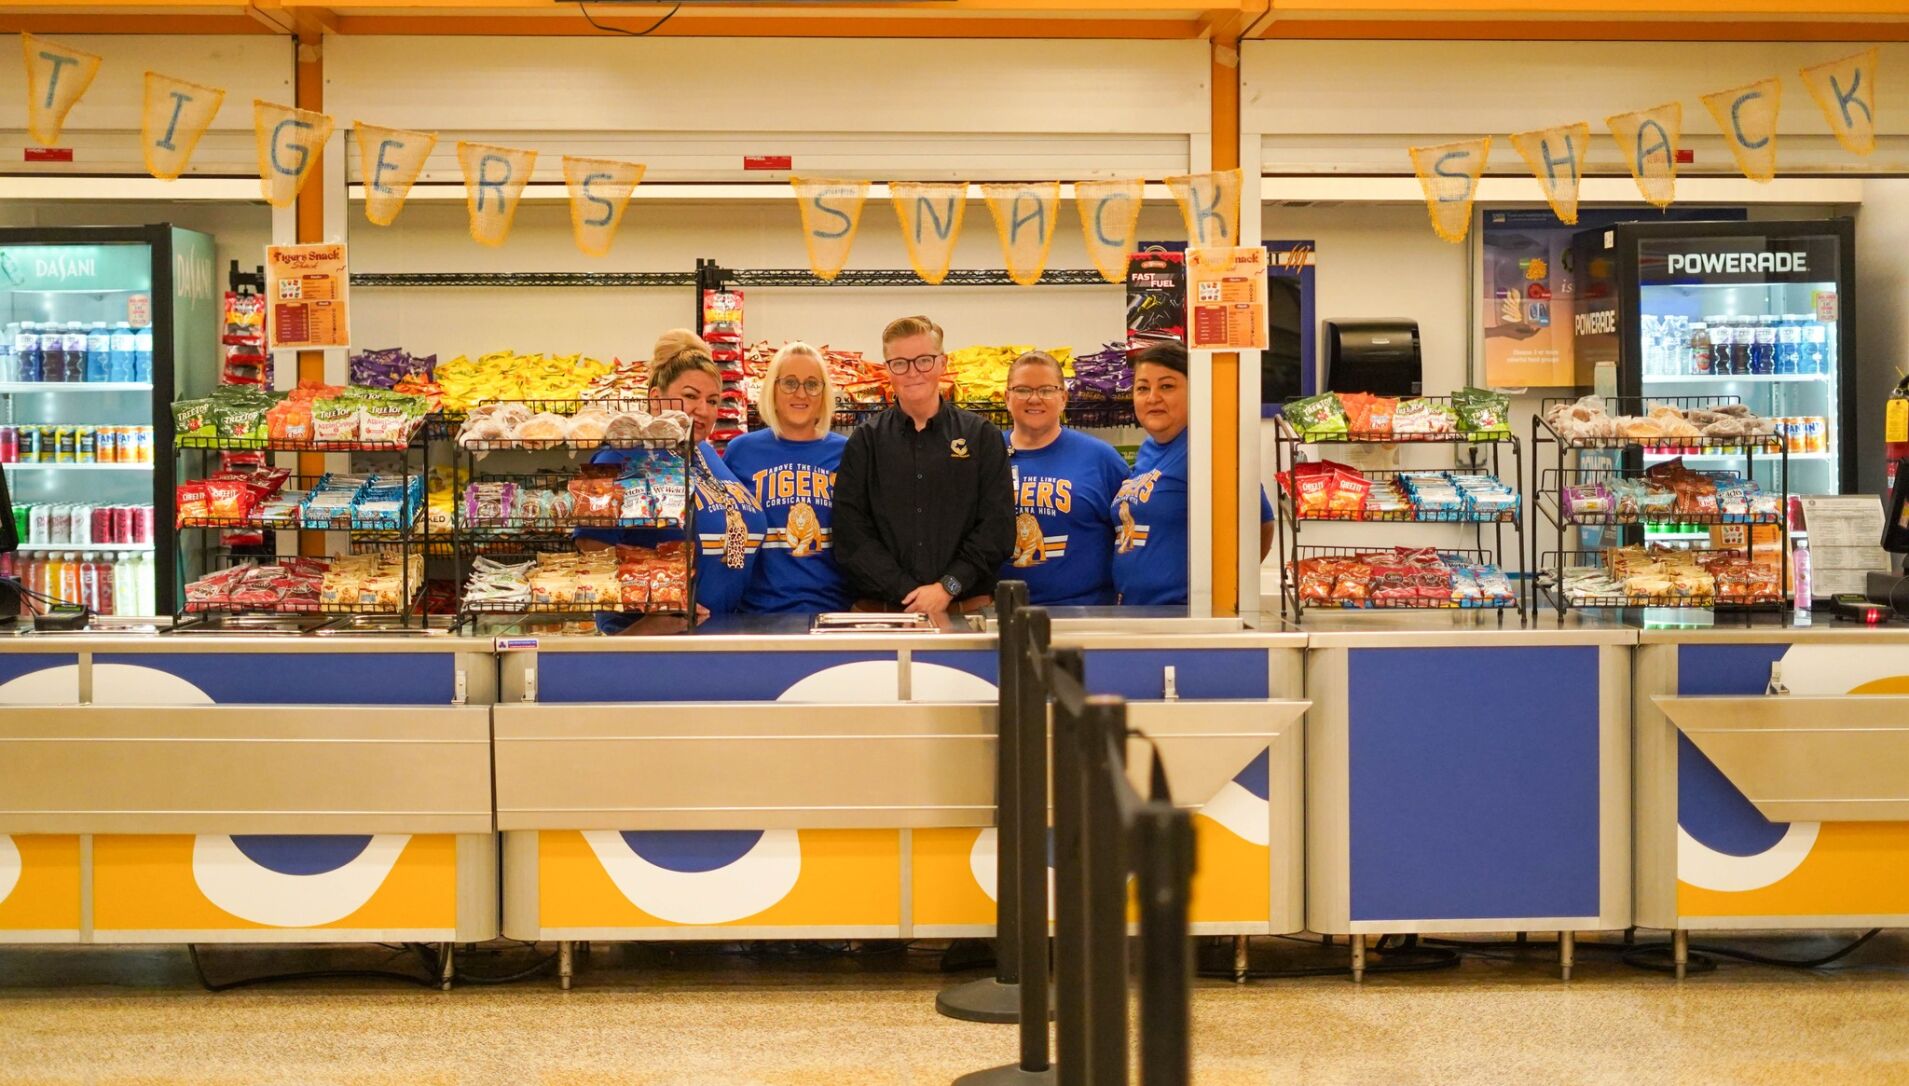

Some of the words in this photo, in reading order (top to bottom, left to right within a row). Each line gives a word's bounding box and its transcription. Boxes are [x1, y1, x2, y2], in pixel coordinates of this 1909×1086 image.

[308, 249, 340, 261] Snack
[35, 255, 96, 282] DASANI
[1667, 252, 1807, 274] POWERADE
[1131, 273, 1155, 281] FAST
[1151, 280, 1175, 288] FUEL
[1575, 310, 1616, 336] POWERADE
[768, 463, 793, 474] ABOVE
[796, 463, 811, 471] THE
[813, 465, 830, 475] LINE
[766, 496, 812, 508] CORSICANA
[1038, 508, 1056, 517] HIGH
